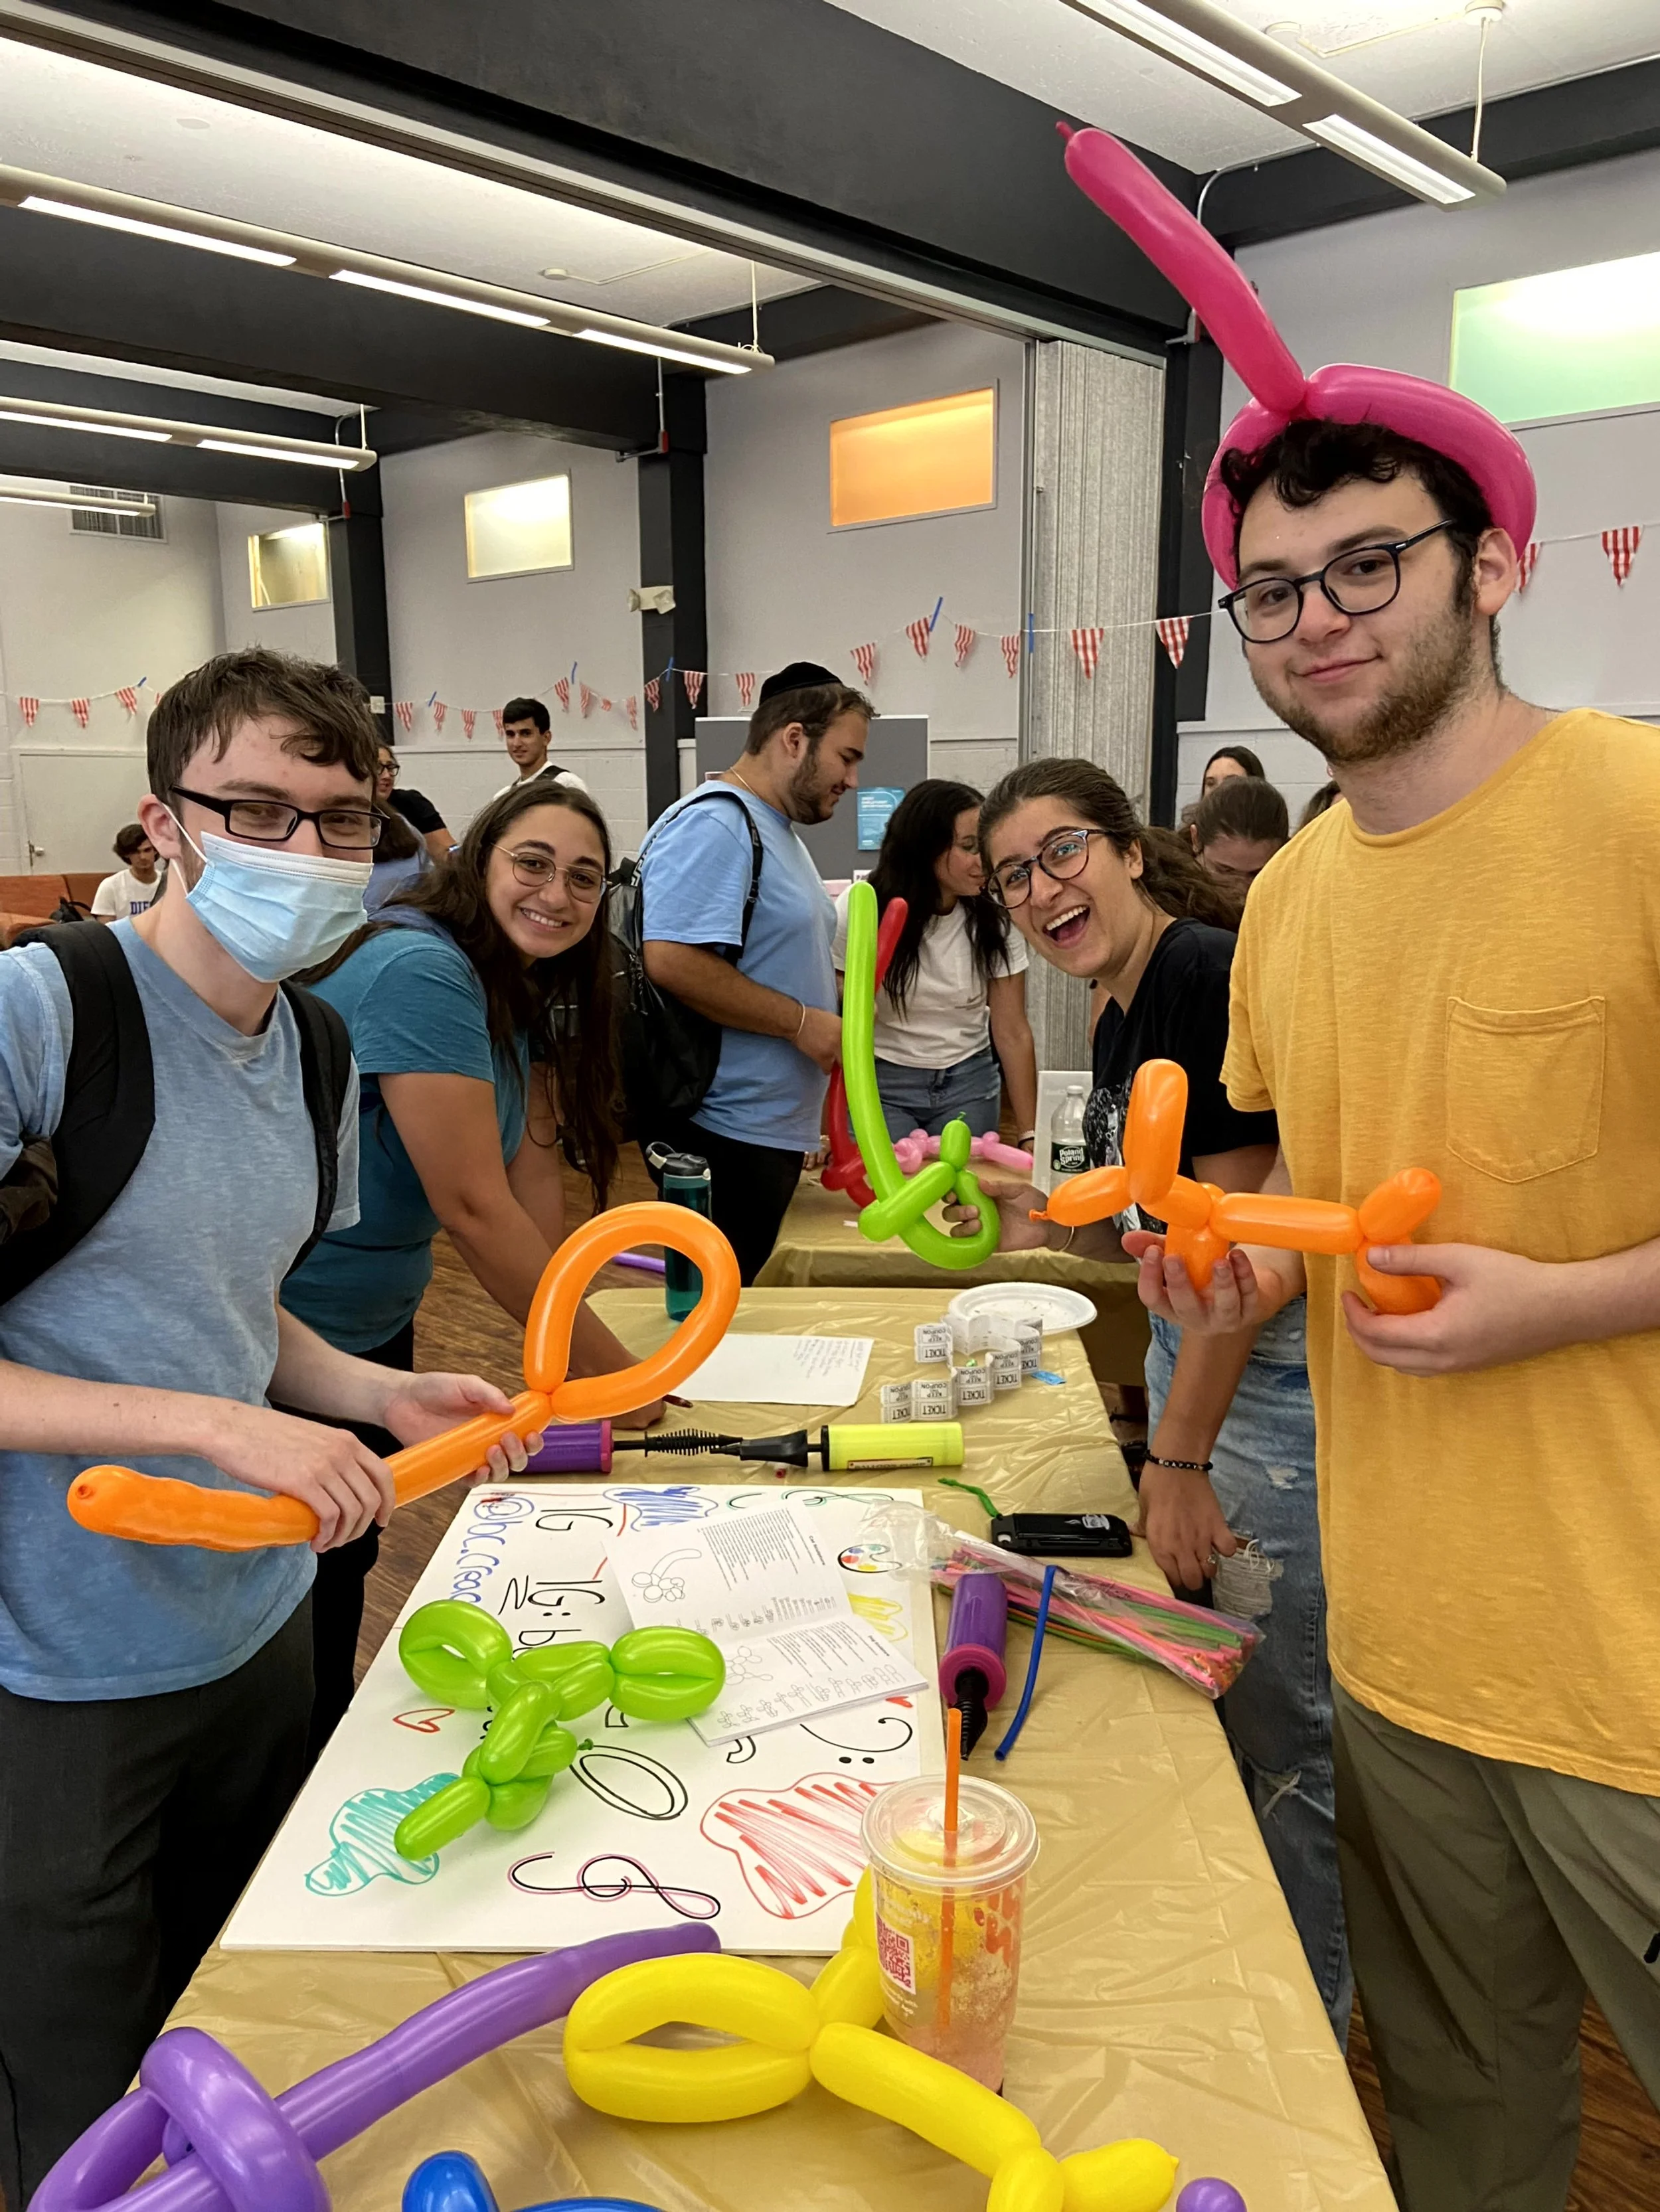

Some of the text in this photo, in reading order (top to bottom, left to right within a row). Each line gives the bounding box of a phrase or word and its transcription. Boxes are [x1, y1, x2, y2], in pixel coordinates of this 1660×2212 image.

[1059, 1147, 1084, 1157] Poland
[925, 1349, 946, 1358] TICKET
[1021, 1359, 1037, 1370] TICKE
[997, 1374, 1018, 1385] TICKET
[962, 1390, 985, 1401] TICKET
[922, 1405, 946, 1415] TICKET
[535, 1507, 614, 1531] IG
